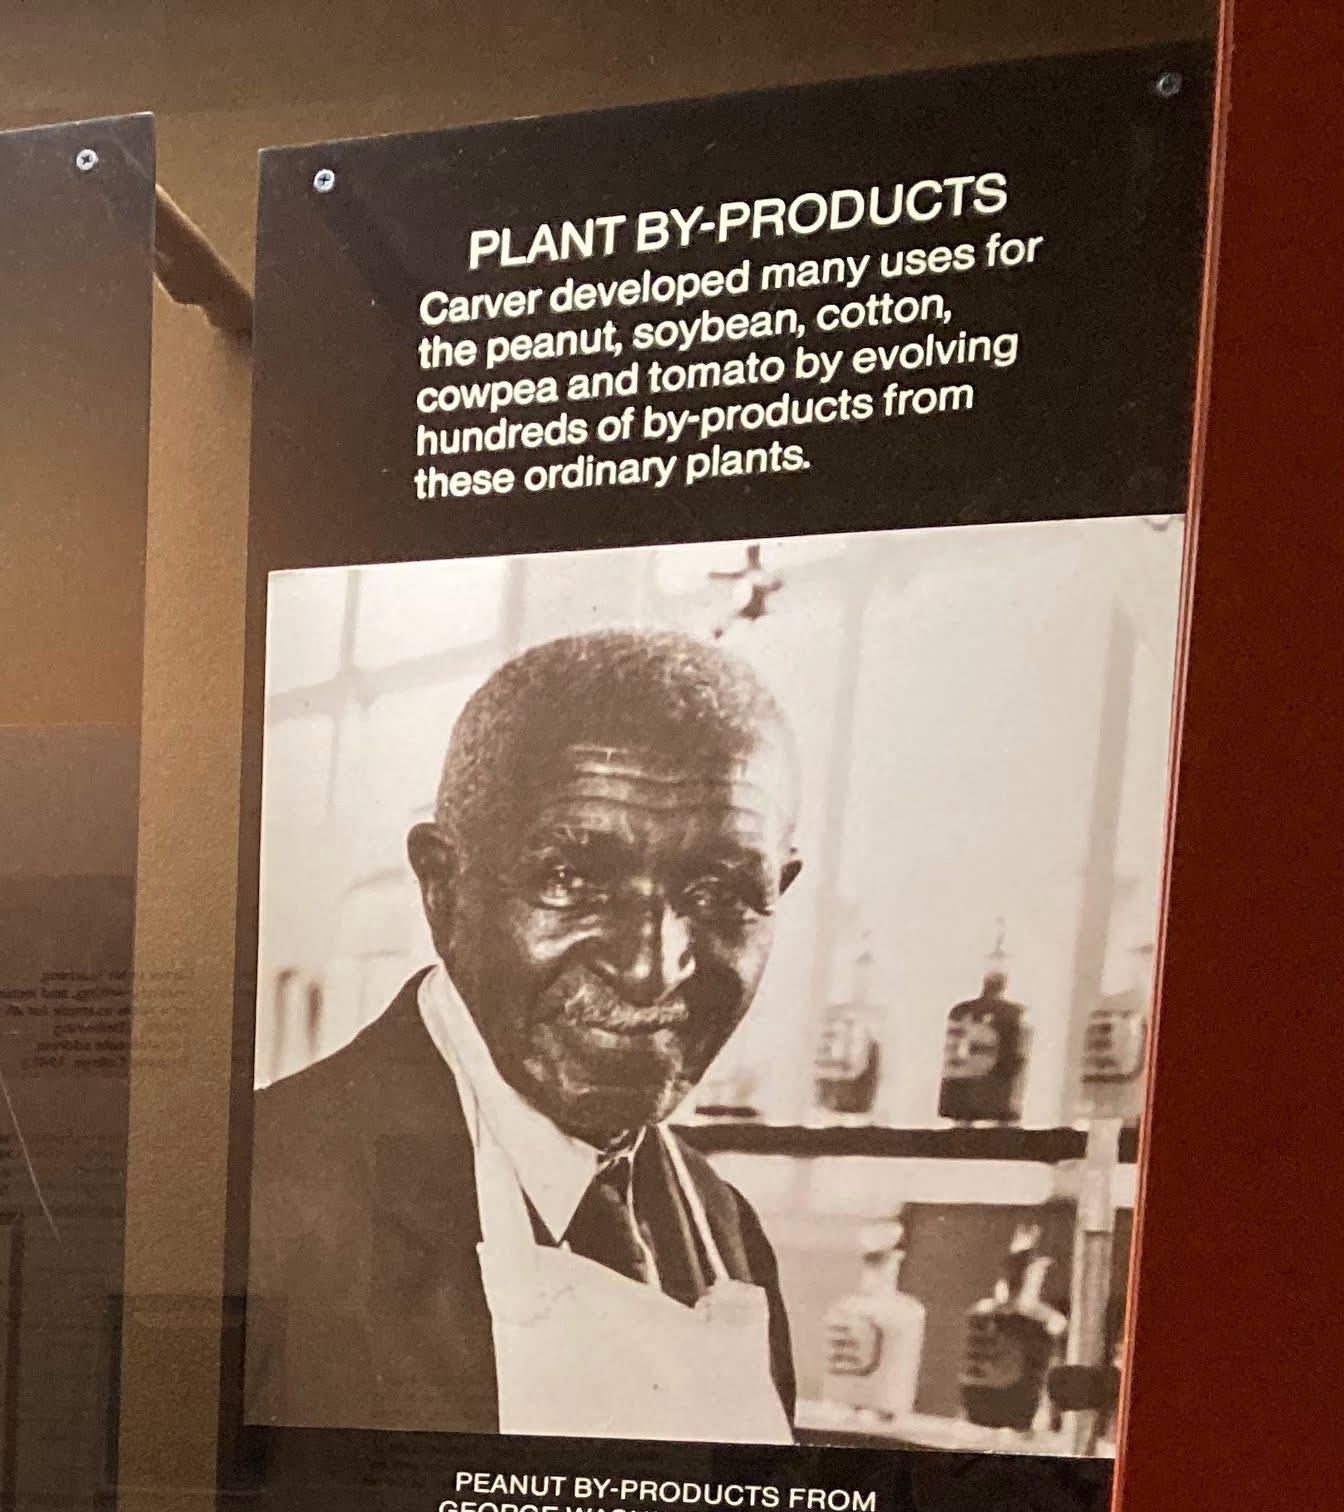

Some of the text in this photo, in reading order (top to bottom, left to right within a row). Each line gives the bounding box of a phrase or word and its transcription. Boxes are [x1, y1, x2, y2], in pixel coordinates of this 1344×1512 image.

[469, 173, 1007, 270] PLANT BY-PRODUCTS
[420, 233, 1043, 325] Carver developed many uses for
[418, 293, 951, 369] the peanut, soybean, cotton,
[417, 383, 973, 456] hundreds of by-products from
[456, 1471, 876, 1512] PEANUT BY-PRODUCTS FROM
